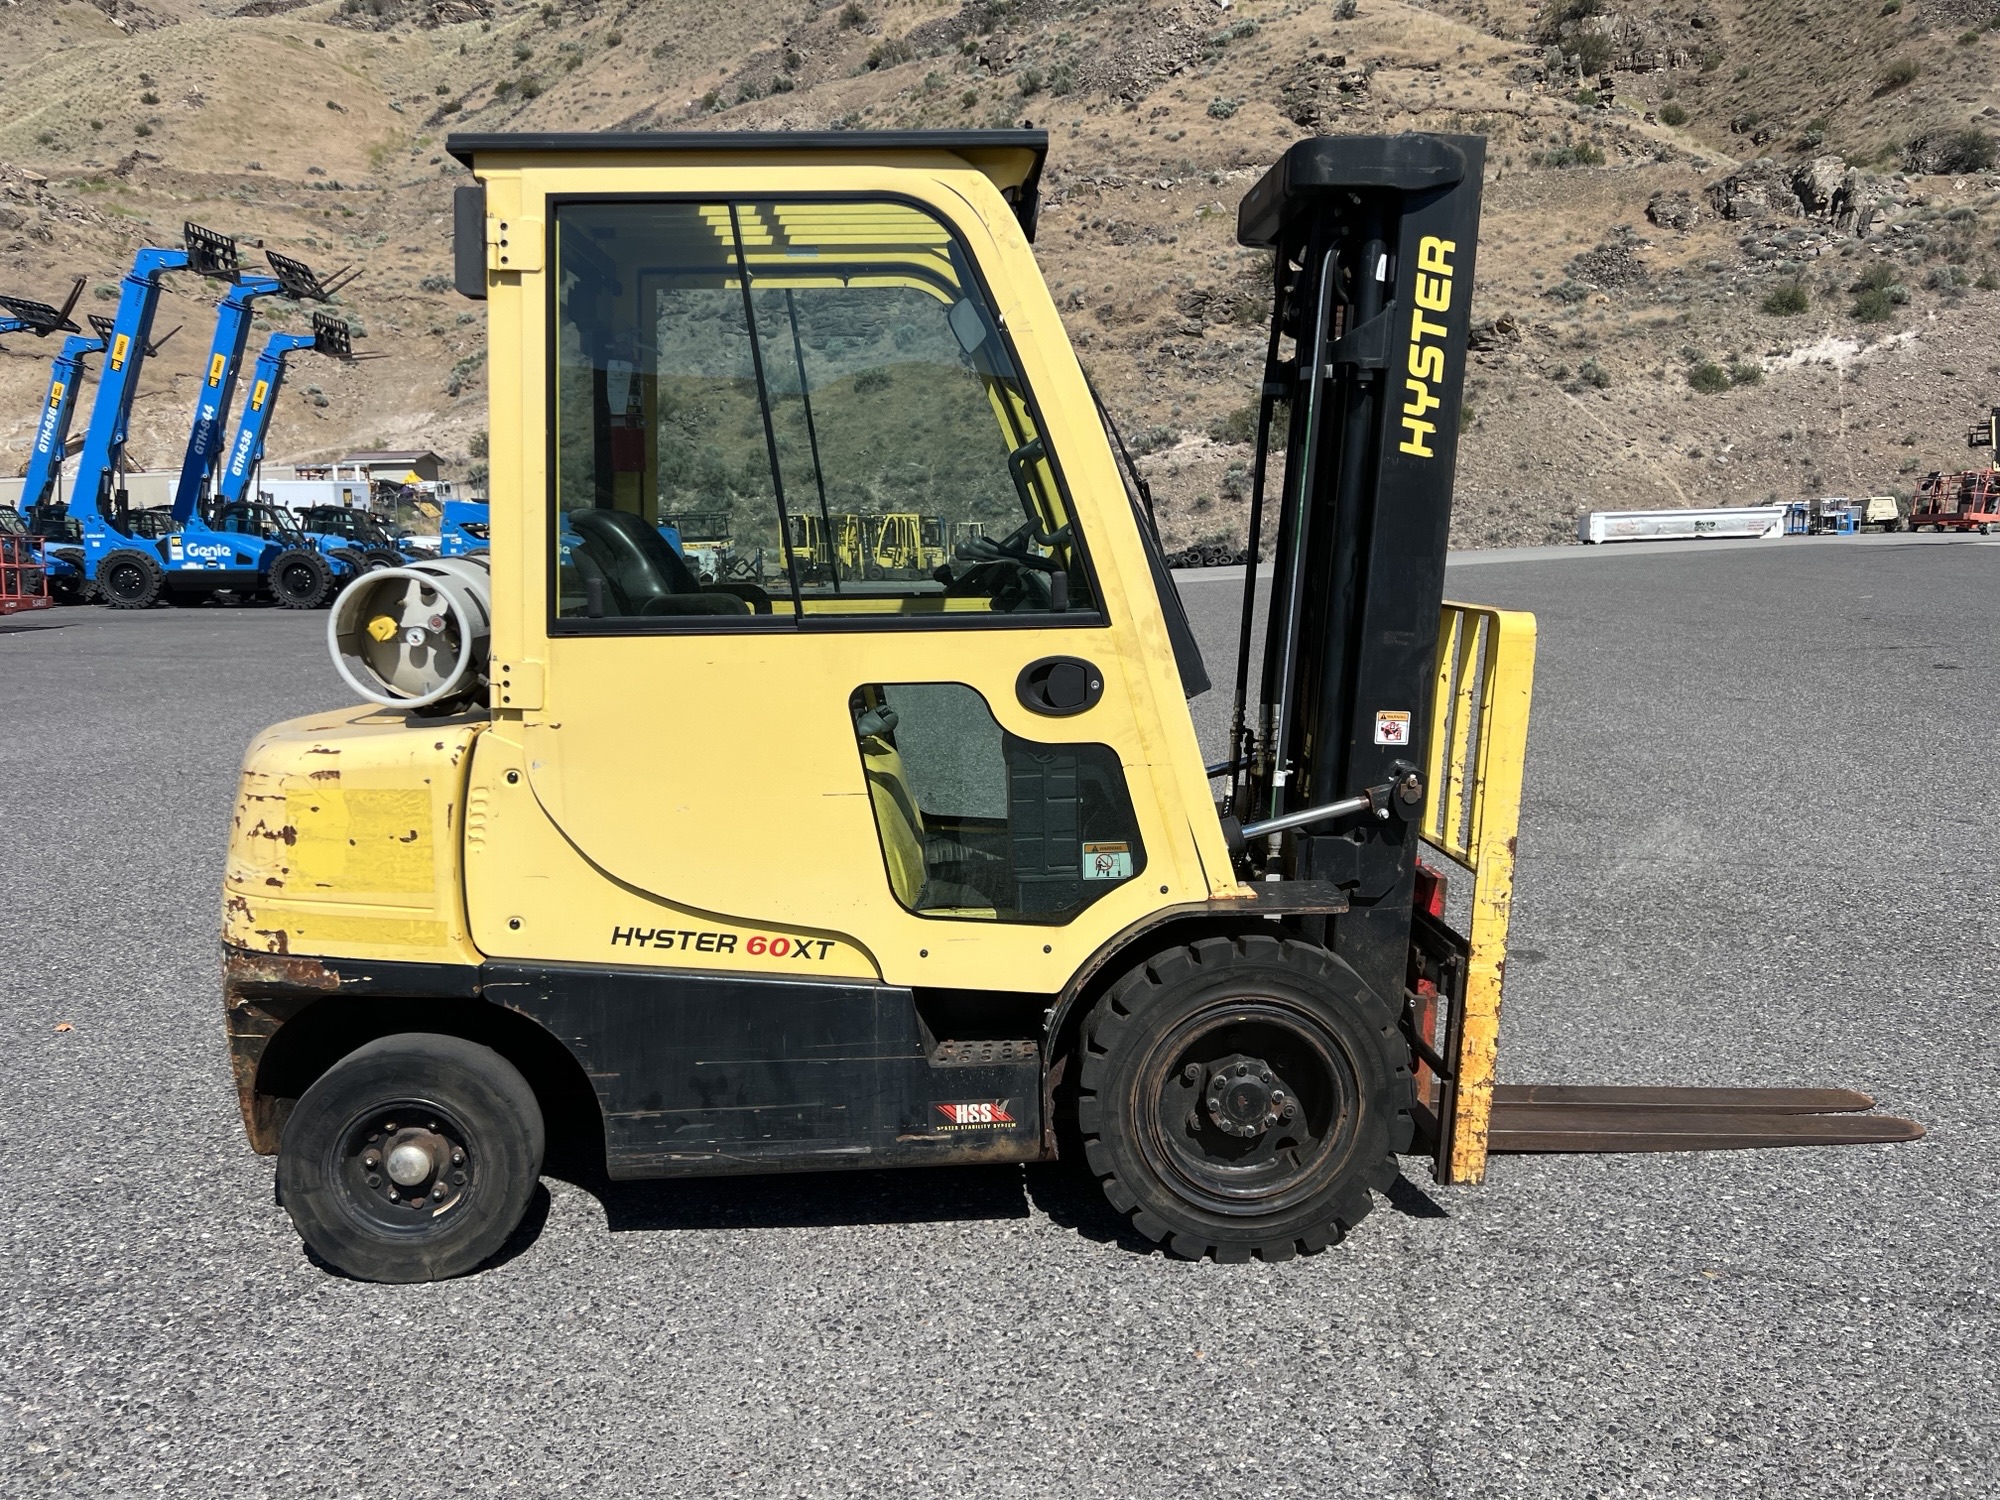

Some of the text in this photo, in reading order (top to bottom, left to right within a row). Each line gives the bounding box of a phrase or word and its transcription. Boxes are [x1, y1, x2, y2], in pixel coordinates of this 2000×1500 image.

[1399, 235, 1457, 459] HYSTER
[38, 406, 58, 454] GTH-636
[194, 403, 215, 456] GTH-844
[231, 429, 253, 477] GTH-636
[186, 542, 232, 558] Genie
[611, 926, 836, 960] HYSTER 60XT
[955, 1103, 993, 1124] HSS
